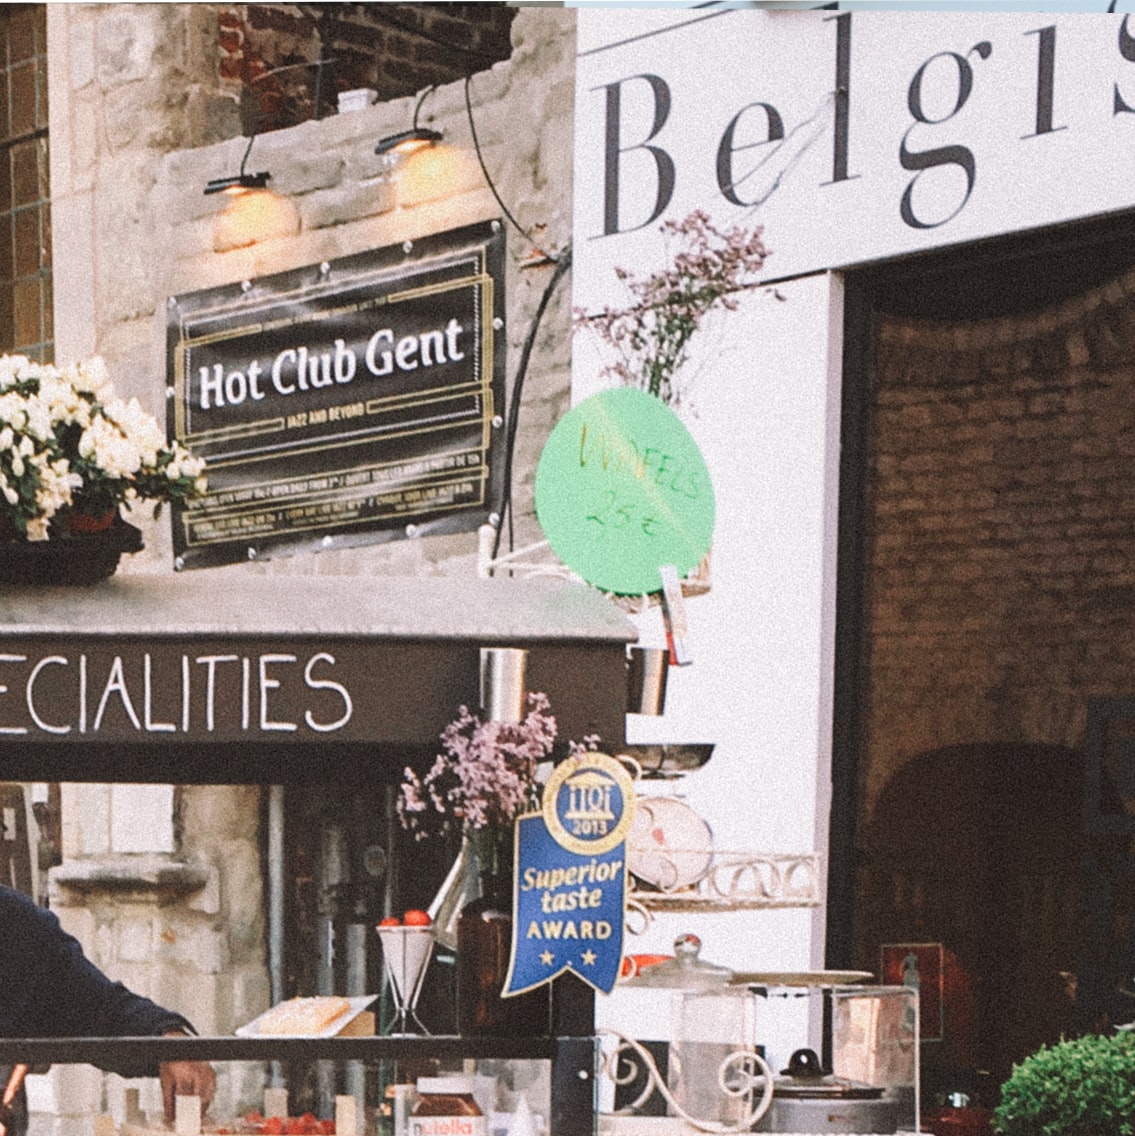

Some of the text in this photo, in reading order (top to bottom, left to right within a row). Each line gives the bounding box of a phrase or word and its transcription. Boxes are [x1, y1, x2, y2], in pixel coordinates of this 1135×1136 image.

[199, 318, 464, 409] Hot Club Gent
[310, 409, 326, 426] AND
[572, 820, 608, 835] 2013
[521, 858, 622, 891] Superior
[541, 886, 602, 914] taste
[526, 920, 612, 940] AWARD
